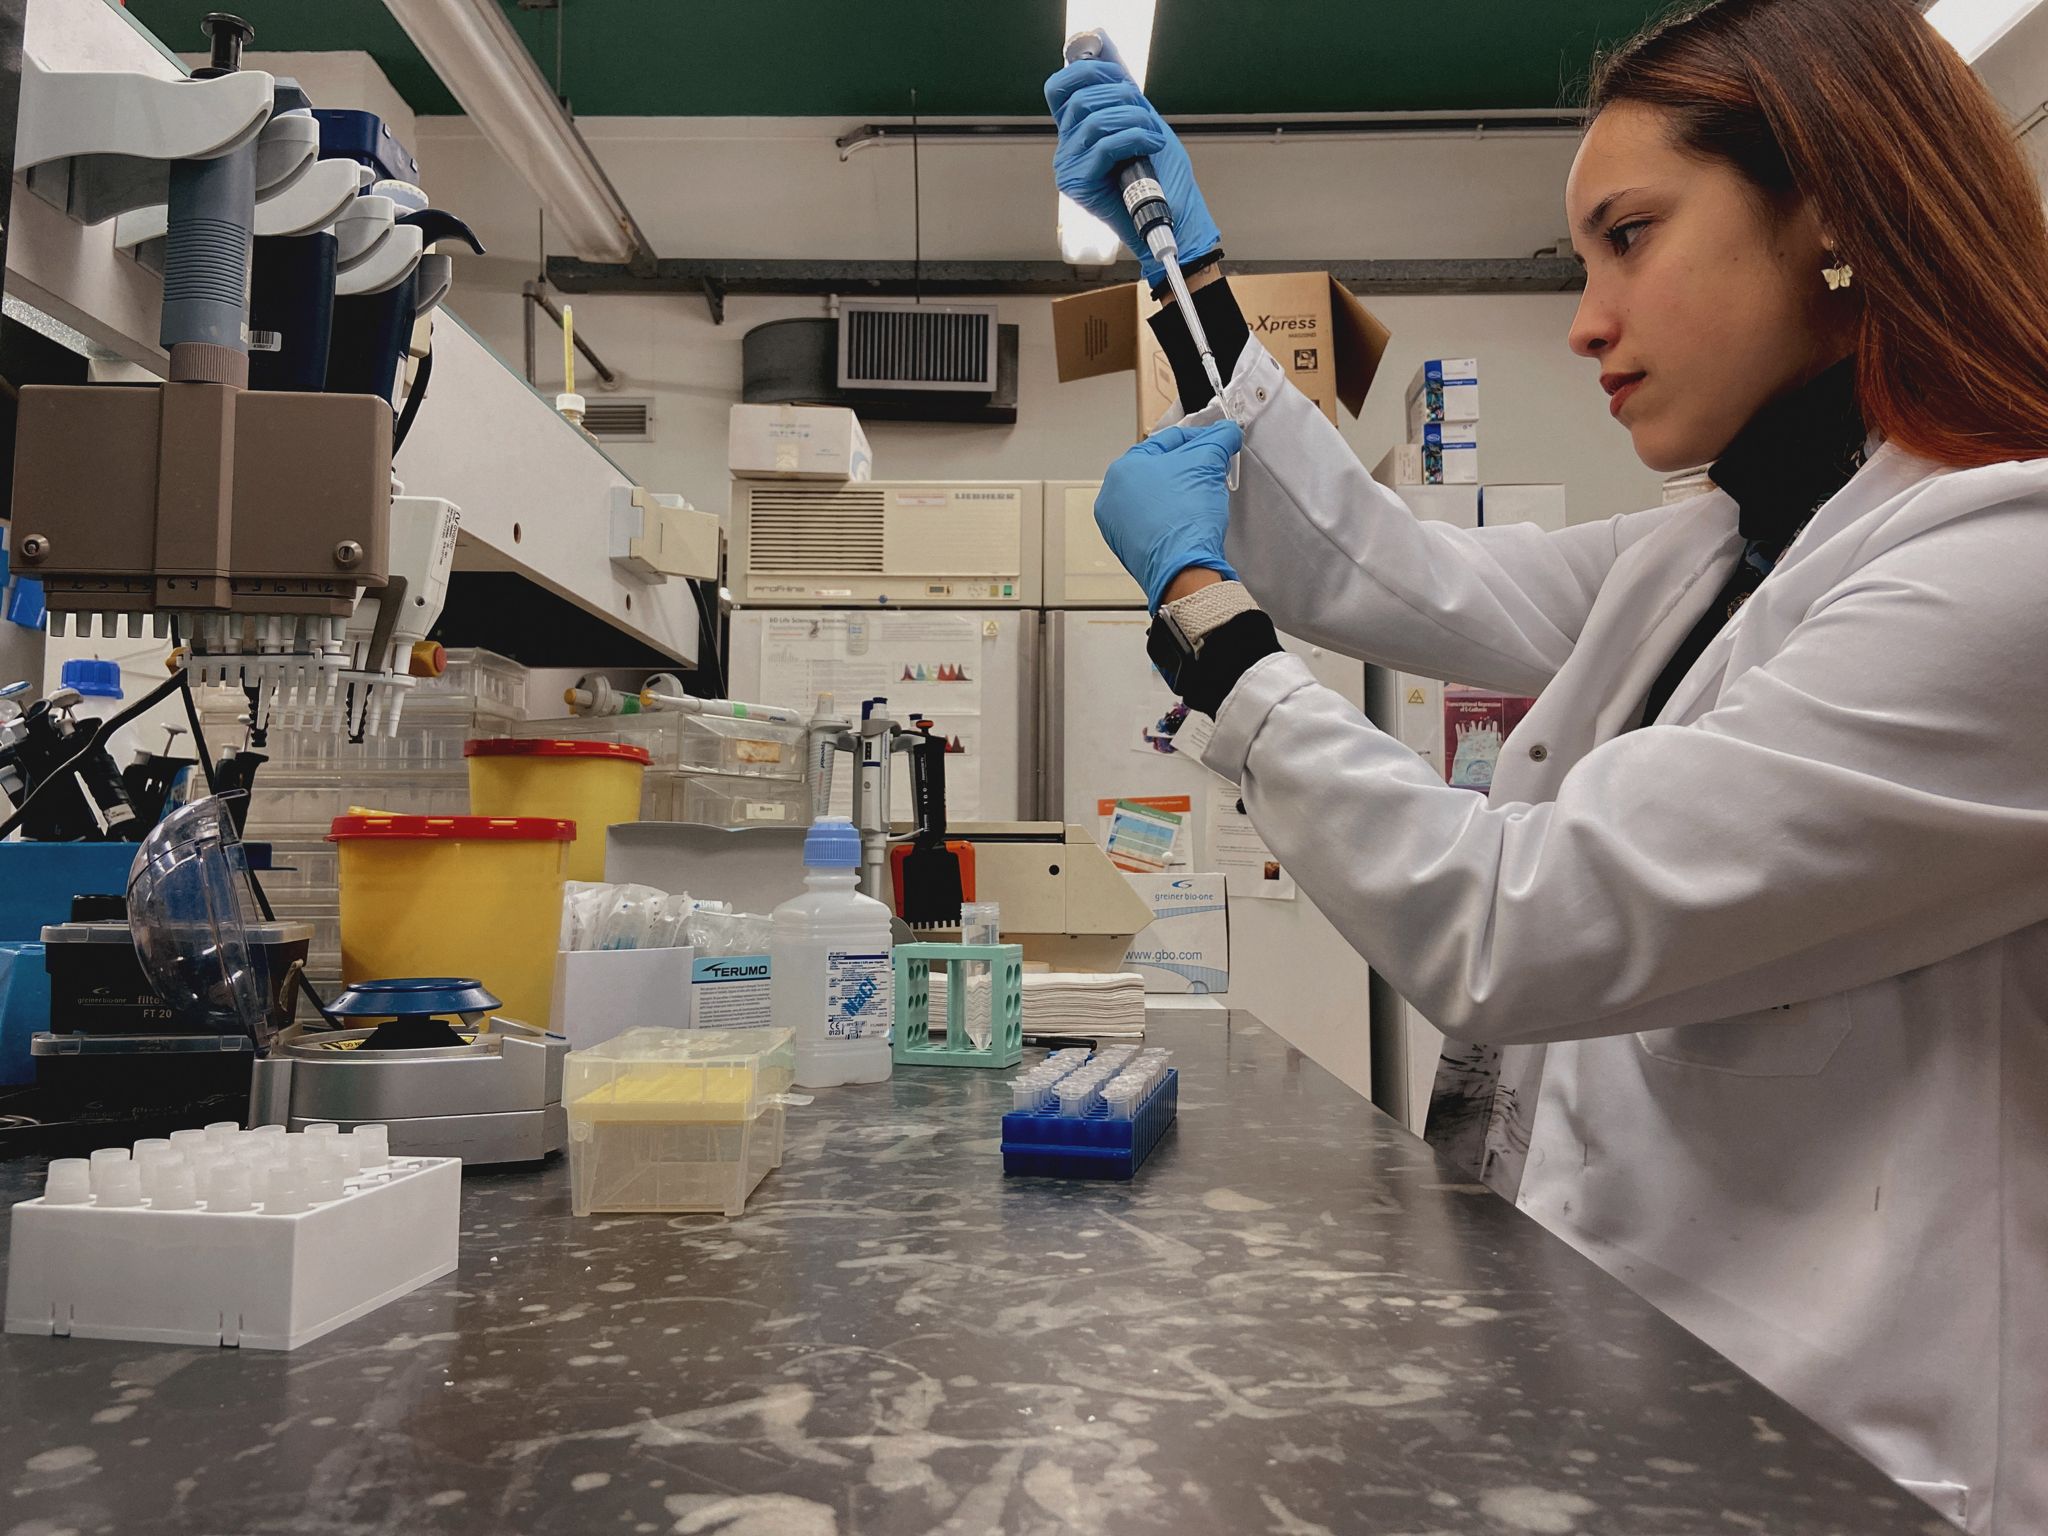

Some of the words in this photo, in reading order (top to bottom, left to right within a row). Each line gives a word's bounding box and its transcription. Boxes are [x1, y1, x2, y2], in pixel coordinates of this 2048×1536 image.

[1155, 893, 1183, 901] greiner
[1125, 949, 1203, 962] www.gbo.com
[711, 966, 768, 977] TERUMO
[144, 1009, 156, 1018] FT
[159, 1009, 172, 1018] 20
